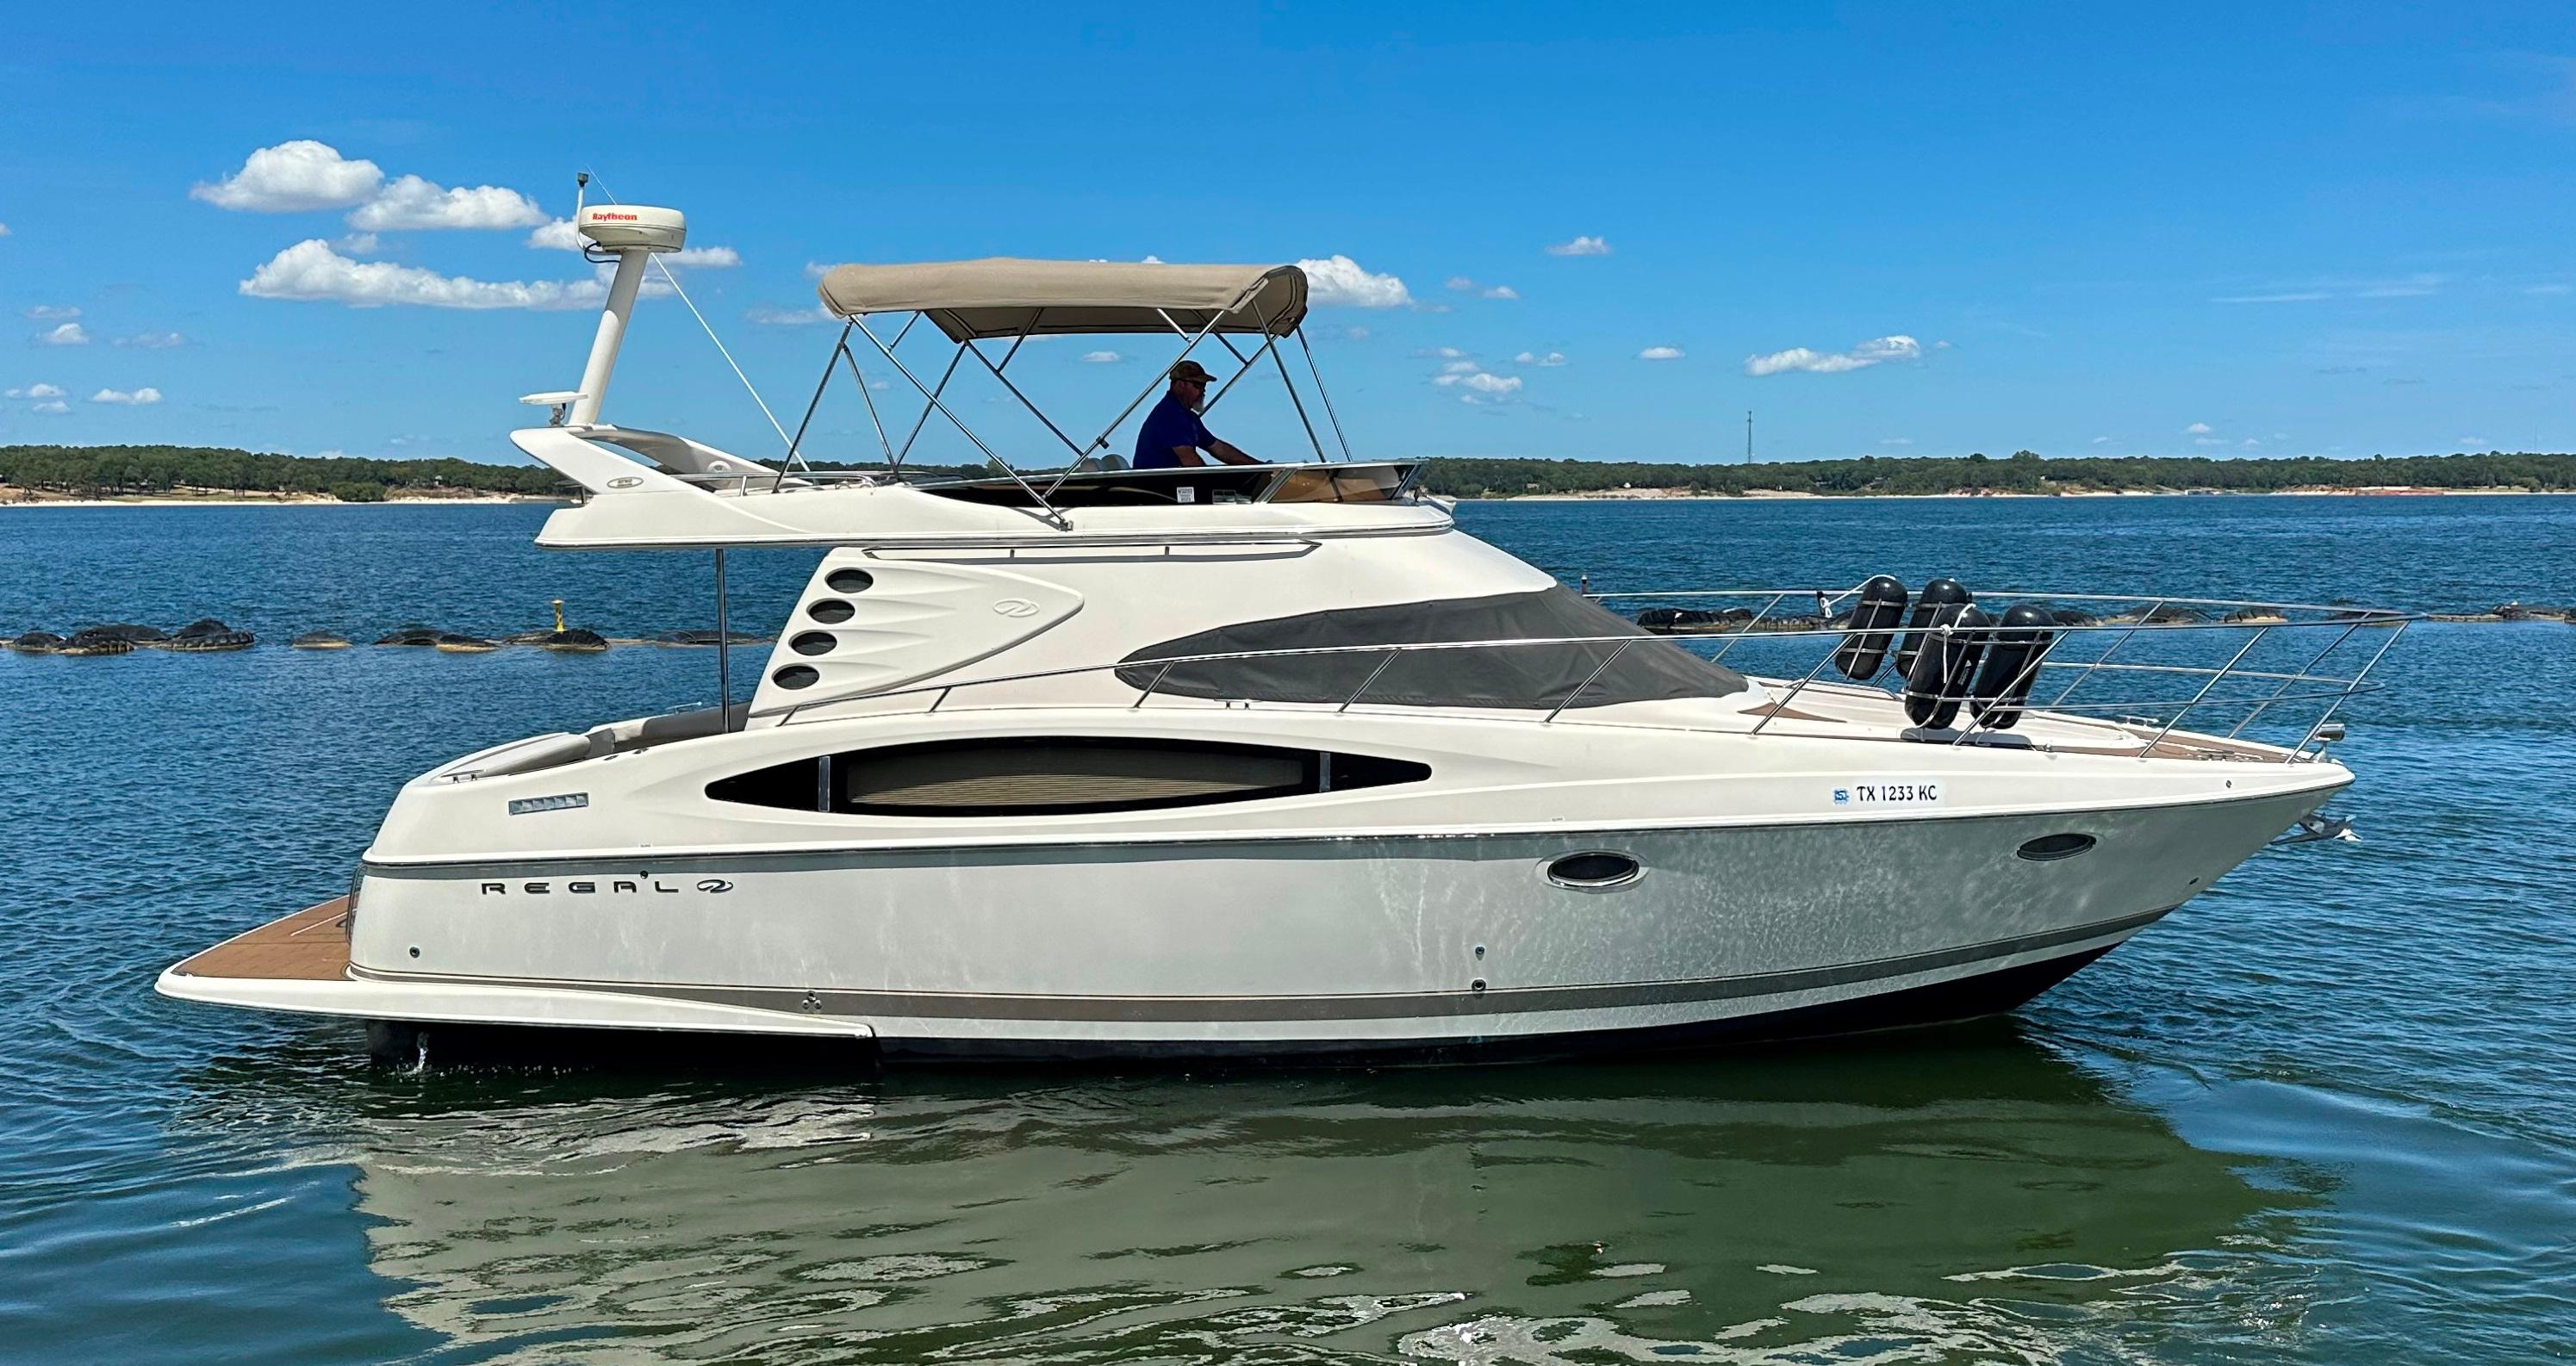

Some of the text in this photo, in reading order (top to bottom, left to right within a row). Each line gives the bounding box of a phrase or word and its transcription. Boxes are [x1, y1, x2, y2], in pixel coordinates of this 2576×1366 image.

[592, 212, 638, 221] Raytheon
[1857, 785, 1876, 801] TX
[1882, 785, 1913, 801] 1233
[1919, 785, 1938, 800] KC
[481, 881, 679, 895] REGAL
